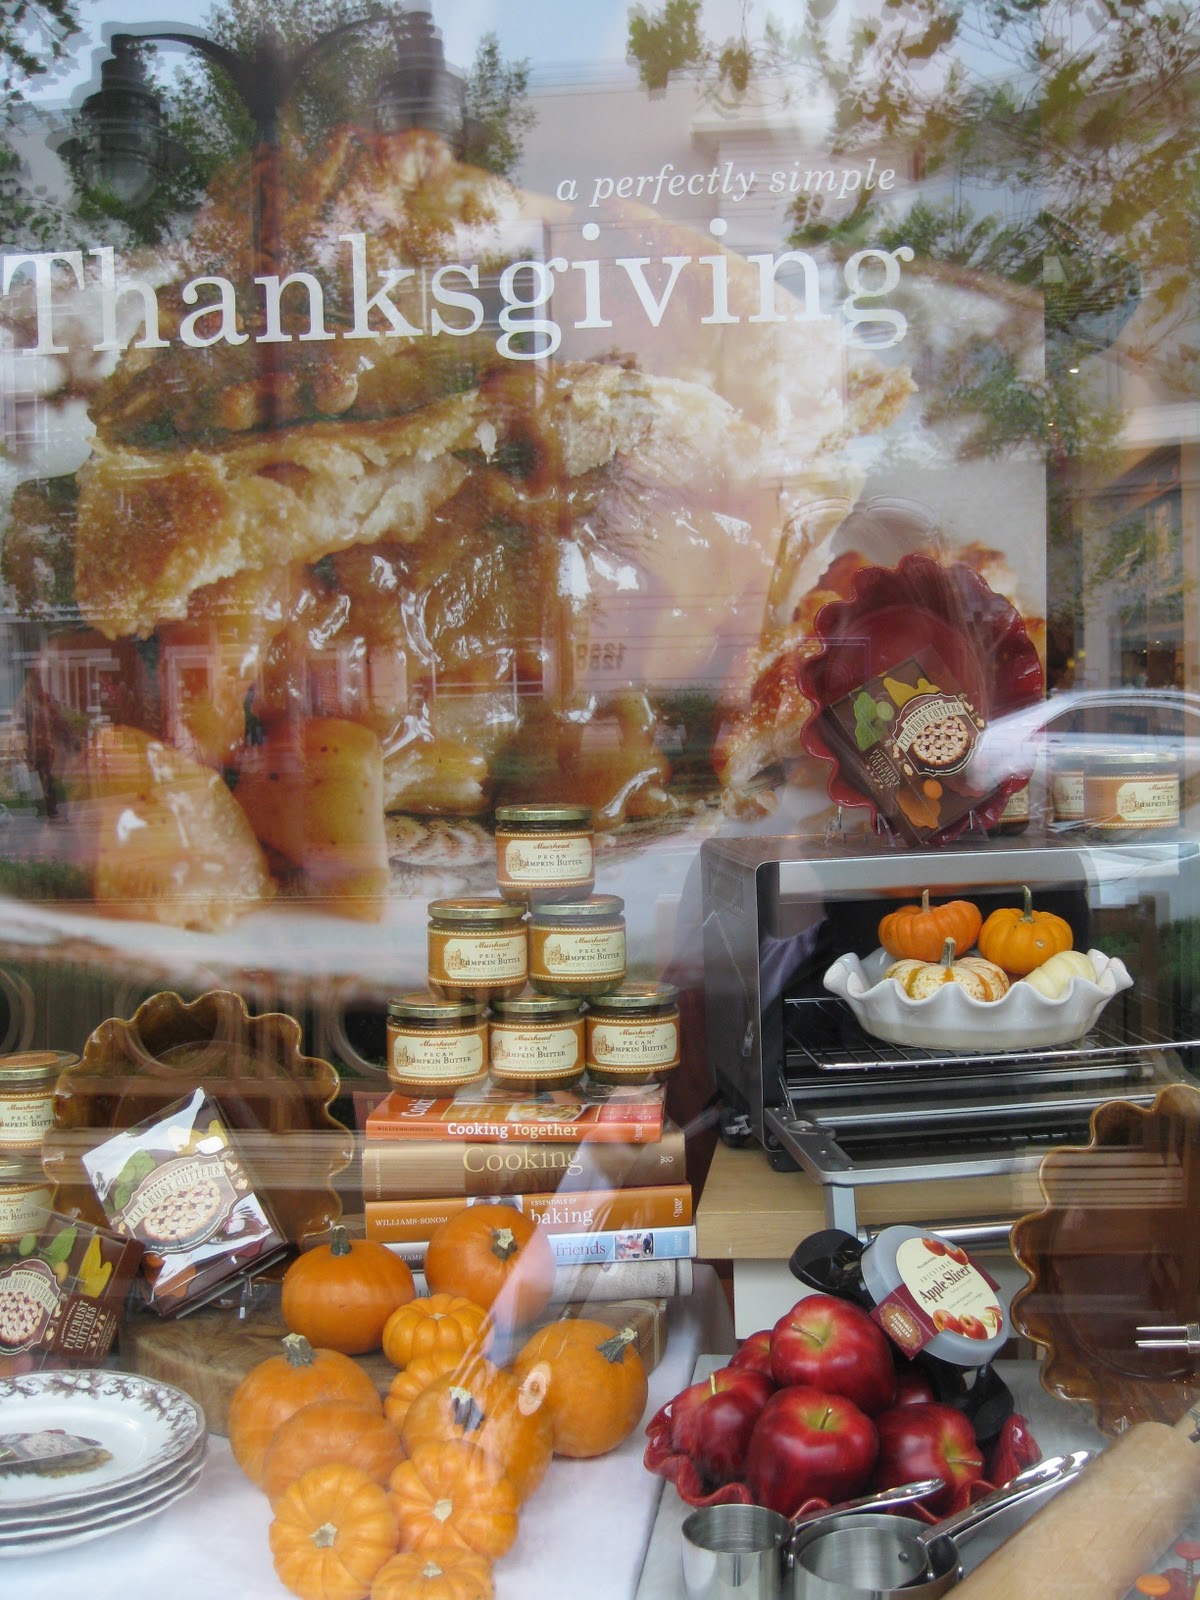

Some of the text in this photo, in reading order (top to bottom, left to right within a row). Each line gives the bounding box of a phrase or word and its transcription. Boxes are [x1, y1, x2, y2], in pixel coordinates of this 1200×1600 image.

[556, 158, 896, 208] a perfectly simple
[2, 217, 915, 362] Thanksgiving
[900, 714, 929, 747] PIECRUST
[928, 704, 963, 720] CUTTERS
[533, 841, 572, 850] Muirhead
[519, 858, 583, 867] PUMPKIN BUTTER
[474, 940, 512, 949] Muirhead
[574, 935, 611, 944] Muirhead
[459, 957, 496, 966] PUMPKIN
[559, 952, 620, 961] PUMPKIN BUTTER
[619, 1027, 657, 1036] Muirhead
[514, 1033, 553, 1042] Muirhead
[419, 1039, 459, 1048] Muirhead
[605, 1043, 668, 1053] PUMPKIN BUTTER
[406, 1055, 472, 1065] PUMPKIN BUTTER
[501, 1050, 566, 1059] PUMPKIN BUTTER
[0, 1120, 29, 1128] UMPKIN
[447, 1122, 579, 1139] Cooking Together
[462, 1144, 584, 1177] Cooking
[168, 1164, 194, 1178] LEAVES
[128, 1164, 221, 1225] PIECRUST CUTTERS
[530, 1196, 577, 1207] ESSENTIALS OF
[530, 1207, 594, 1227] baking
[555, 1239, 606, 1257] friends
[918, 1279, 949, 1304] Apple
[942, 1265, 971, 1286] Slicer
[0, 1278, 57, 1310] IECRUST CUTTERS
[63, 1299, 90, 1349] PIECRUST
[74, 1306, 97, 1349] CUTTERS
